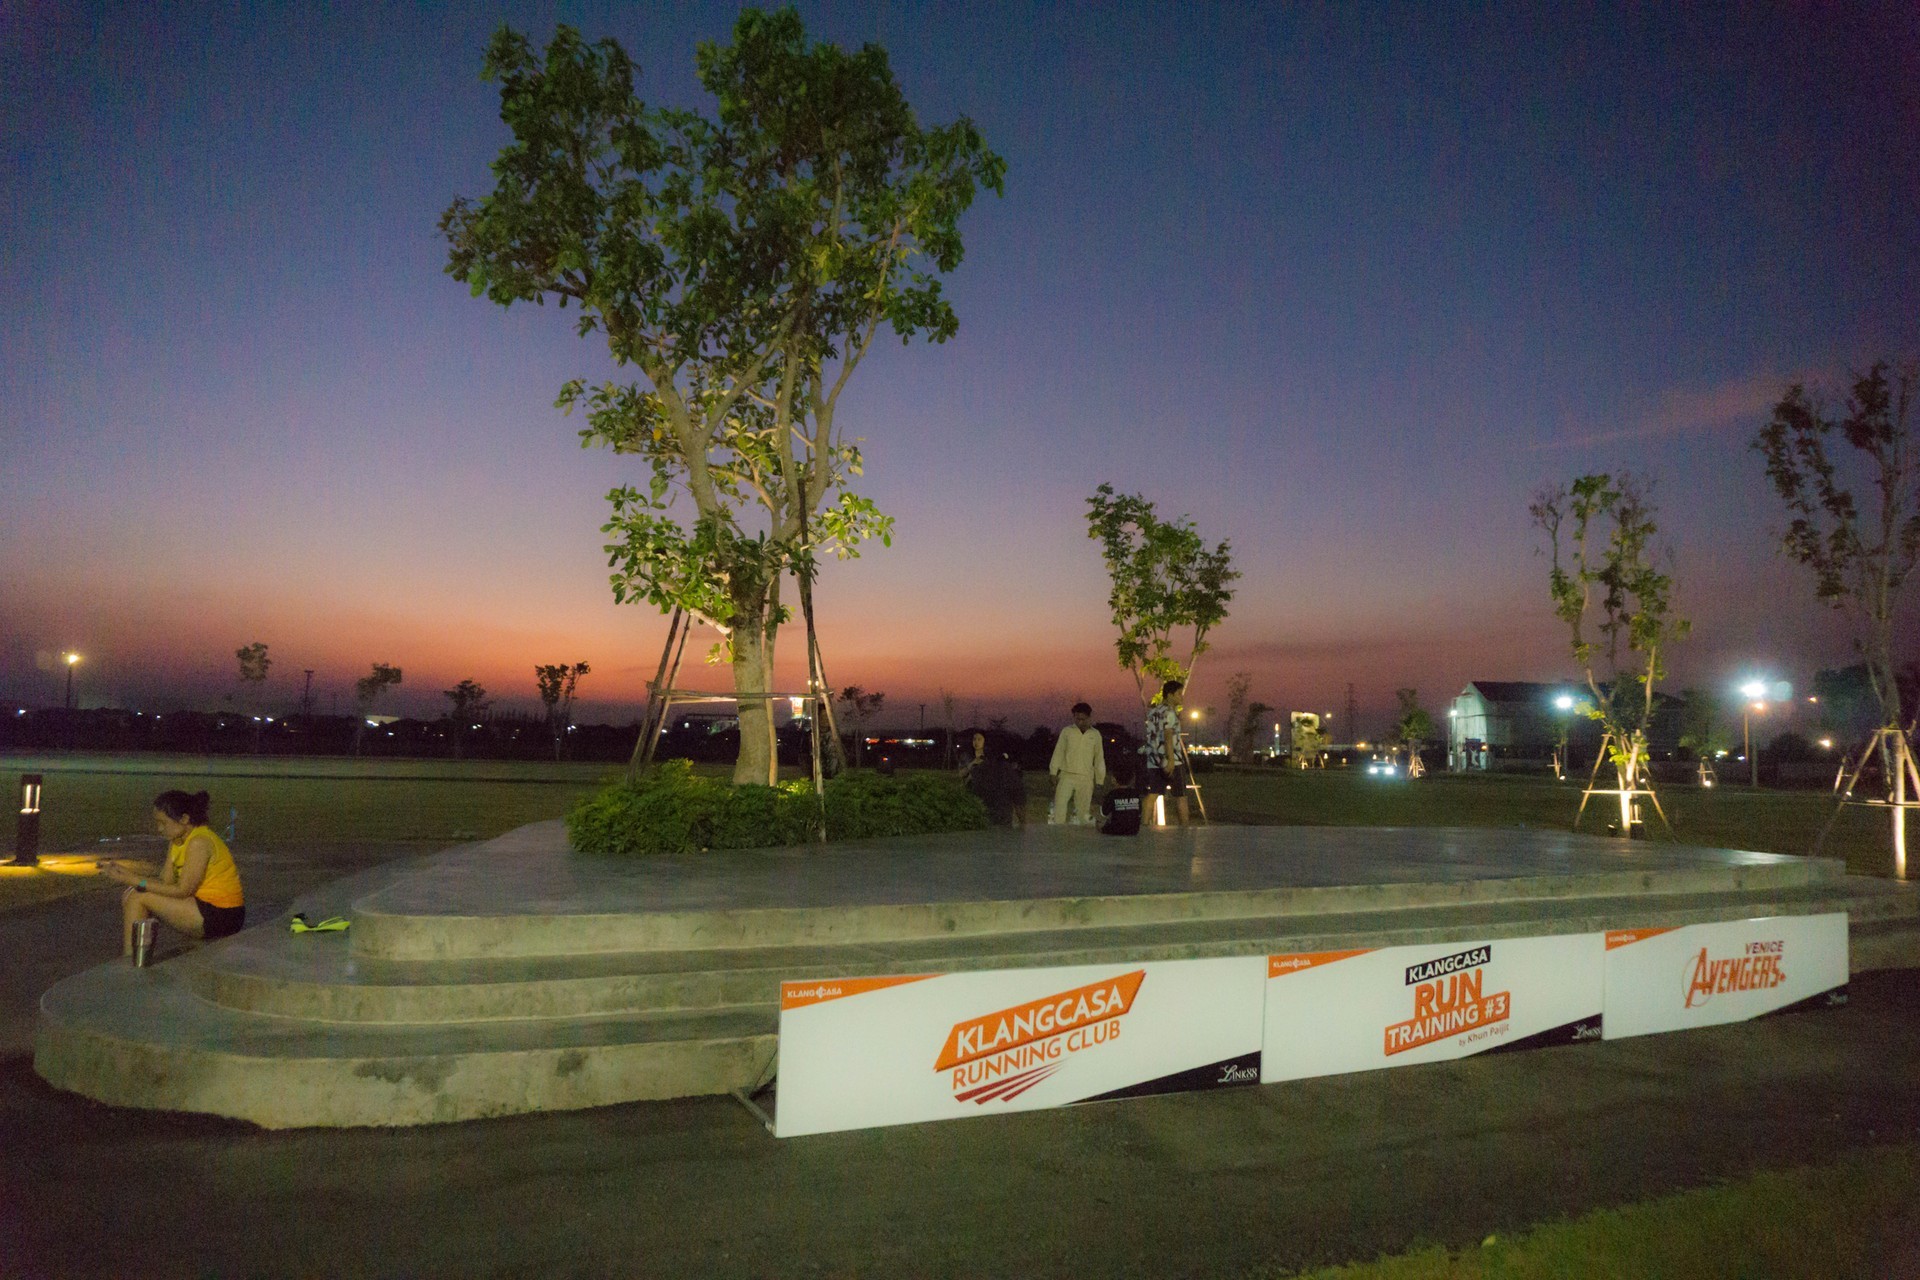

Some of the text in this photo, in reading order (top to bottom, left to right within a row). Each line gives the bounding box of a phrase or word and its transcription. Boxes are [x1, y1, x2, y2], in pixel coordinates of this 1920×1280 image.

[1409, 949, 1488, 982] KLANGCASA
[1745, 940, 1784, 954] VENICE
[1415, 968, 1482, 1018] RUN
[1685, 947, 1783, 1009] AVENGERS
[957, 985, 1124, 1058] KLANGCASA
[1388, 996, 1506, 1048] TRAINING #3
[1468, 1031, 1488, 1043] Khun
[953, 1019, 1121, 1090] RUNNING CLUB
